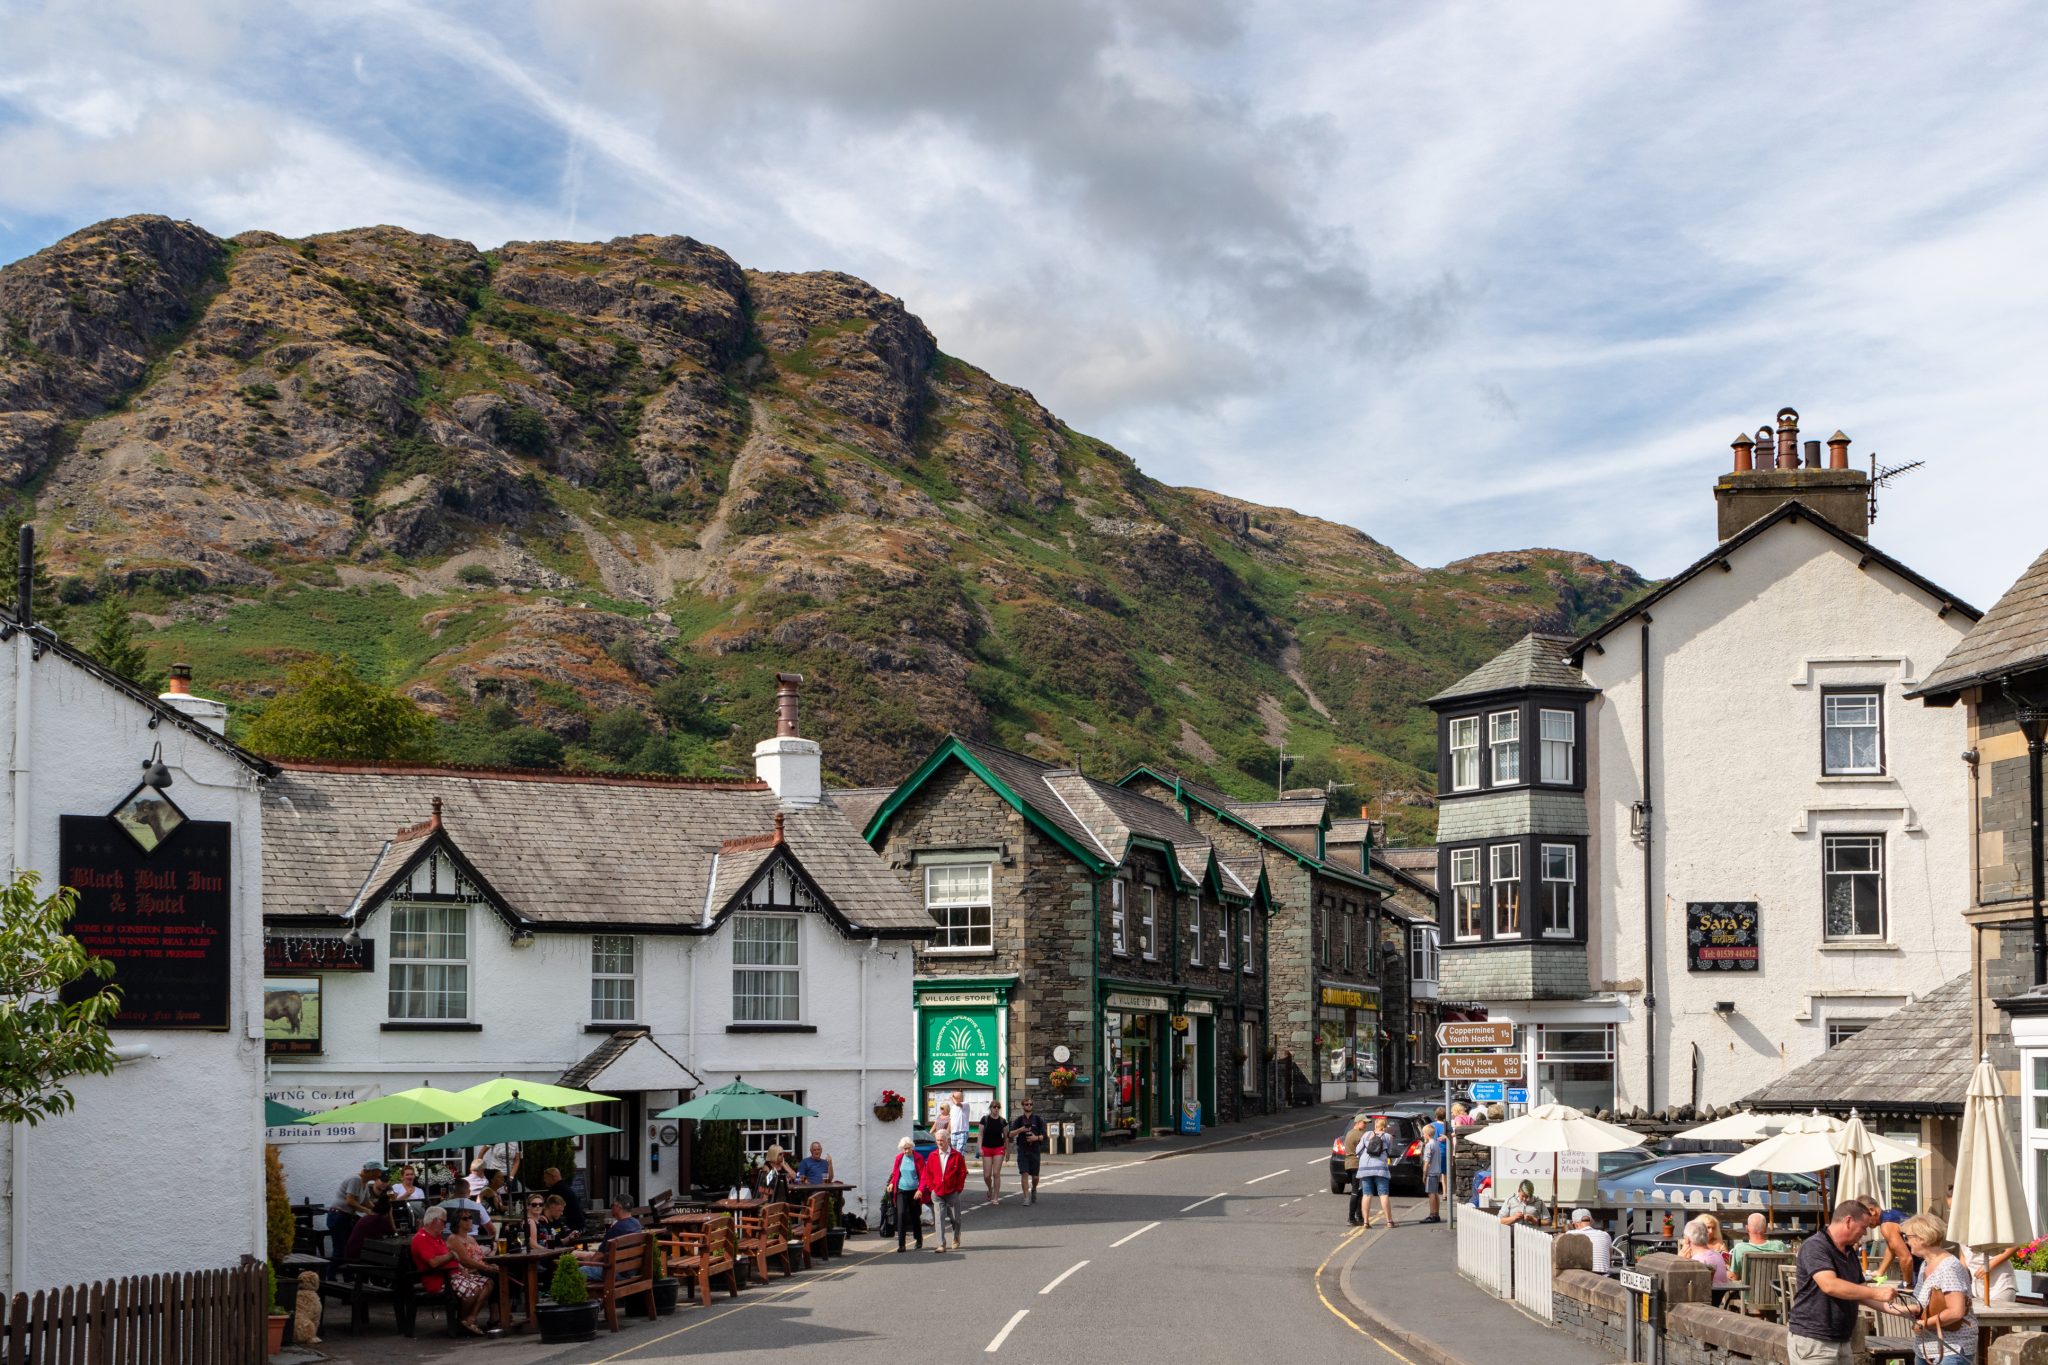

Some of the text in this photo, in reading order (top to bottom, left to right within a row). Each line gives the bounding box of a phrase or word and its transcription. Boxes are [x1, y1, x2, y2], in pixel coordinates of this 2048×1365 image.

[69, 867, 223, 893] Black Bull Inn
[111, 893, 185, 916] & Hotel
[1699, 914, 1751, 931] Sara's
[103, 925, 114, 933] OF
[118, 924, 161, 934] CONISTON
[163, 926, 204, 934] BREWING
[84, 937, 211, 946] AWARD WINNING REAL ALES
[128, 949, 142, 957] ON
[144, 949, 164, 957] THE
[1716, 950, 1734, 958] 01539
[1735, 949, 1756, 958] 441912
[1449, 1026, 1496, 1036] Coppermines
[977, 1028, 986, 1051] SOCIETY
[1449, 1034, 1496, 1043] Youth Hostel
[1456, 1057, 1519, 1067] Holly How 650
[1451, 1066, 1518, 1076] Youth Hostel yds
[265, 1090, 355, 1100] WING Co. Ltd
[279, 1127, 321, 1137] Britain
[326, 1126, 356, 1136] 1998
[1561, 1157, 1589, 1165] Snacks
[1510, 1167, 1552, 1175] CAFÉ
[1561, 1165, 1586, 1174] Meals
[1640, 1275, 1650, 1291] ROAD
